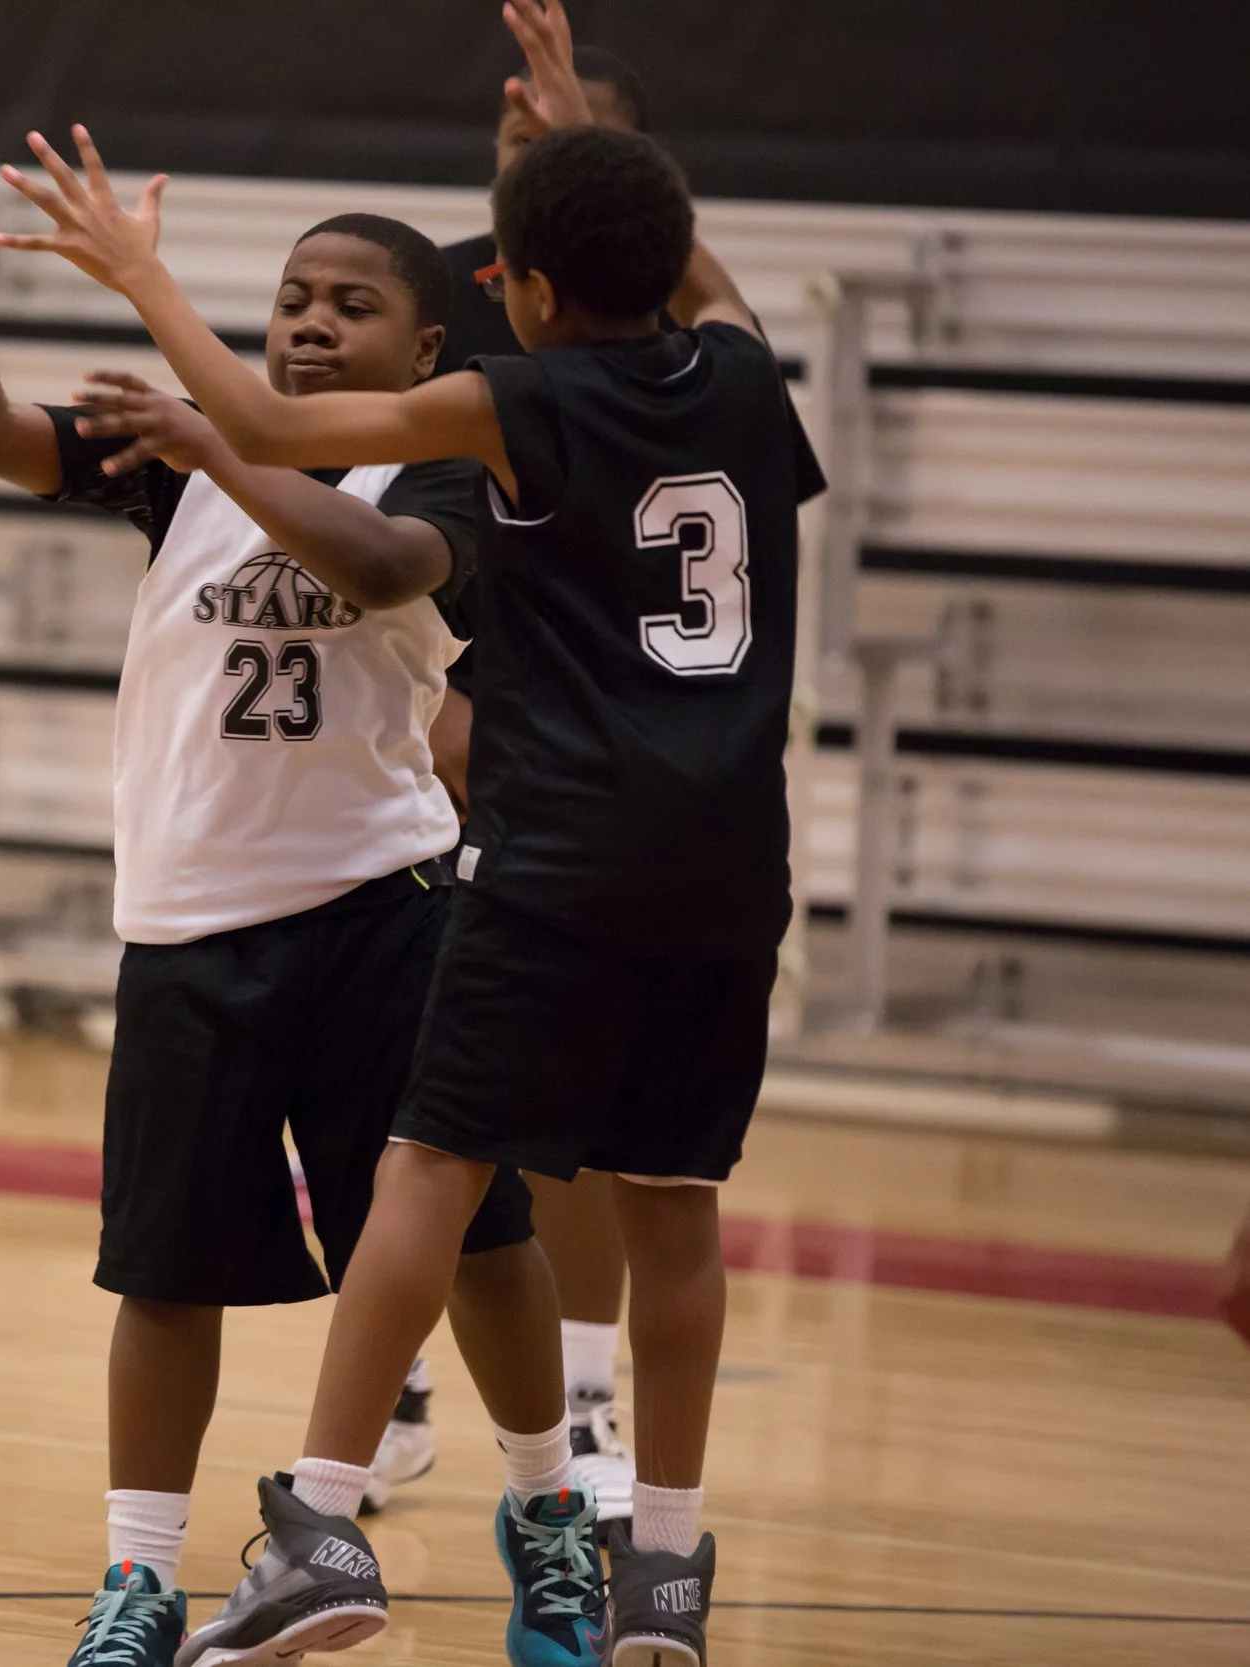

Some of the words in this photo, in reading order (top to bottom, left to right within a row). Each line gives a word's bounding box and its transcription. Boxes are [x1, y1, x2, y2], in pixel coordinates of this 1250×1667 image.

[634, 471, 752, 675] 3
[221, 639, 322, 741] 23
[310, 1536, 379, 1579] NIKE
[653, 1578, 701, 1614] NIKE
